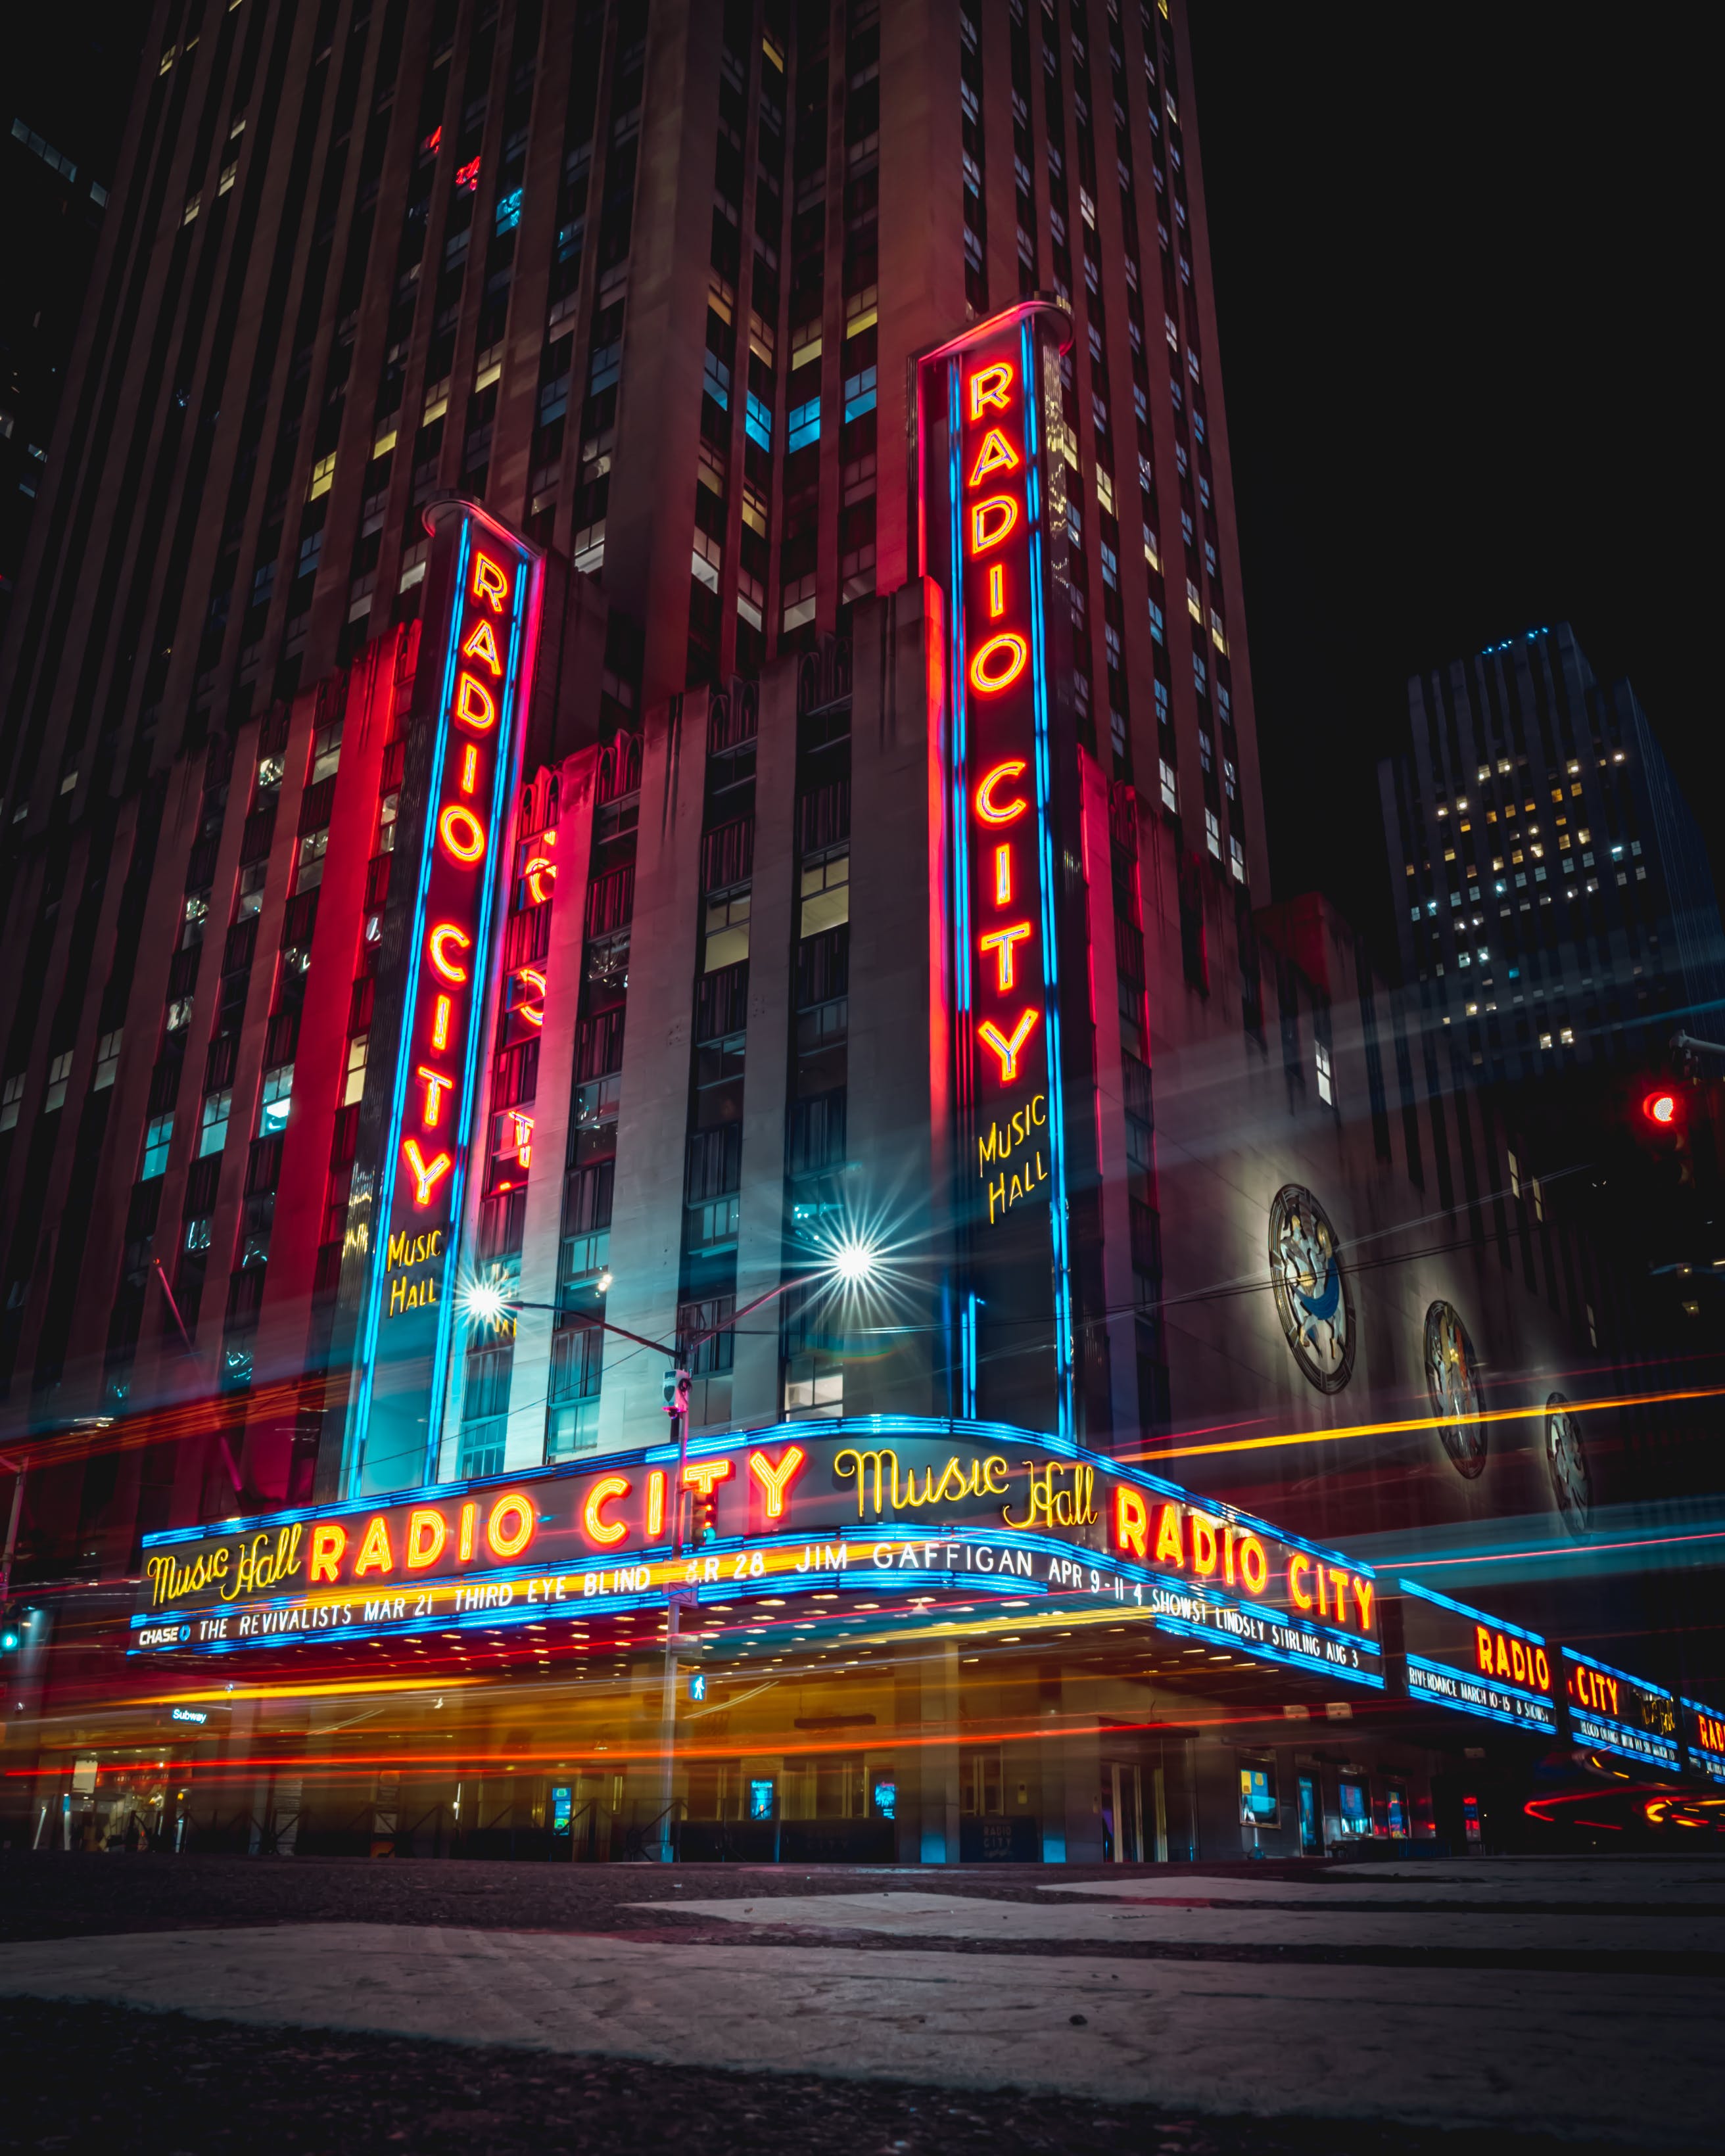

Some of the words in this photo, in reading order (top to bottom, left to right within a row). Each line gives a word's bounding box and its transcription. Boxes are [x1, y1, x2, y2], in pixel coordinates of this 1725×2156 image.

[969, 362, 1028, 694] RADIO
[439, 551, 508, 863] RADIO
[976, 761, 1039, 1082] CITY
[402, 923, 471, 1206] CITY
[147, 1547, 229, 1606] Music
[220, 1523, 302, 1601] Hall
[310, 1493, 534, 1582] RADIO
[834, 1449, 1010, 1517] Music
[1003, 1461, 1099, 1529] Hall
[1116, 1485, 1267, 1595] RADIO
[1288, 1554, 1373, 1630] CITY
[200, 1618, 228, 1640] THE
[239, 1603, 352, 1636] REVIVALISTS
[364, 1597, 405, 1621] MAR
[415, 1593, 433, 1616] 21
[455, 1585, 513, 1612] THIRD
[528, 1576, 567, 1603] EYE
[584, 1567, 651, 1597] BLIND
[734, 1552, 765, 1580] 28
[795, 1543, 848, 1573] JIM
[872, 1542, 1033, 1577] GAFFIGAN
[1049, 1557, 1083, 1589] APR
[1151, 1588, 1207, 1622] SHOWS!
[139, 1627, 178, 1646] CHASE
[1215, 1606, 1264, 1641] LINDSEY
[1272, 1625, 1320, 1657] STIRLING
[1326, 1645, 1346, 1666] AUG
[1351, 1650, 1359, 1668] 3
[1476, 1625, 1551, 1691] RADIO
[1576, 1666, 1618, 1715] CITY
[172, 1709, 207, 1724] Subway
[1409, 1666, 1457, 1697] RIVERDANCE
[1460, 1683, 1487, 1706] MARCH
